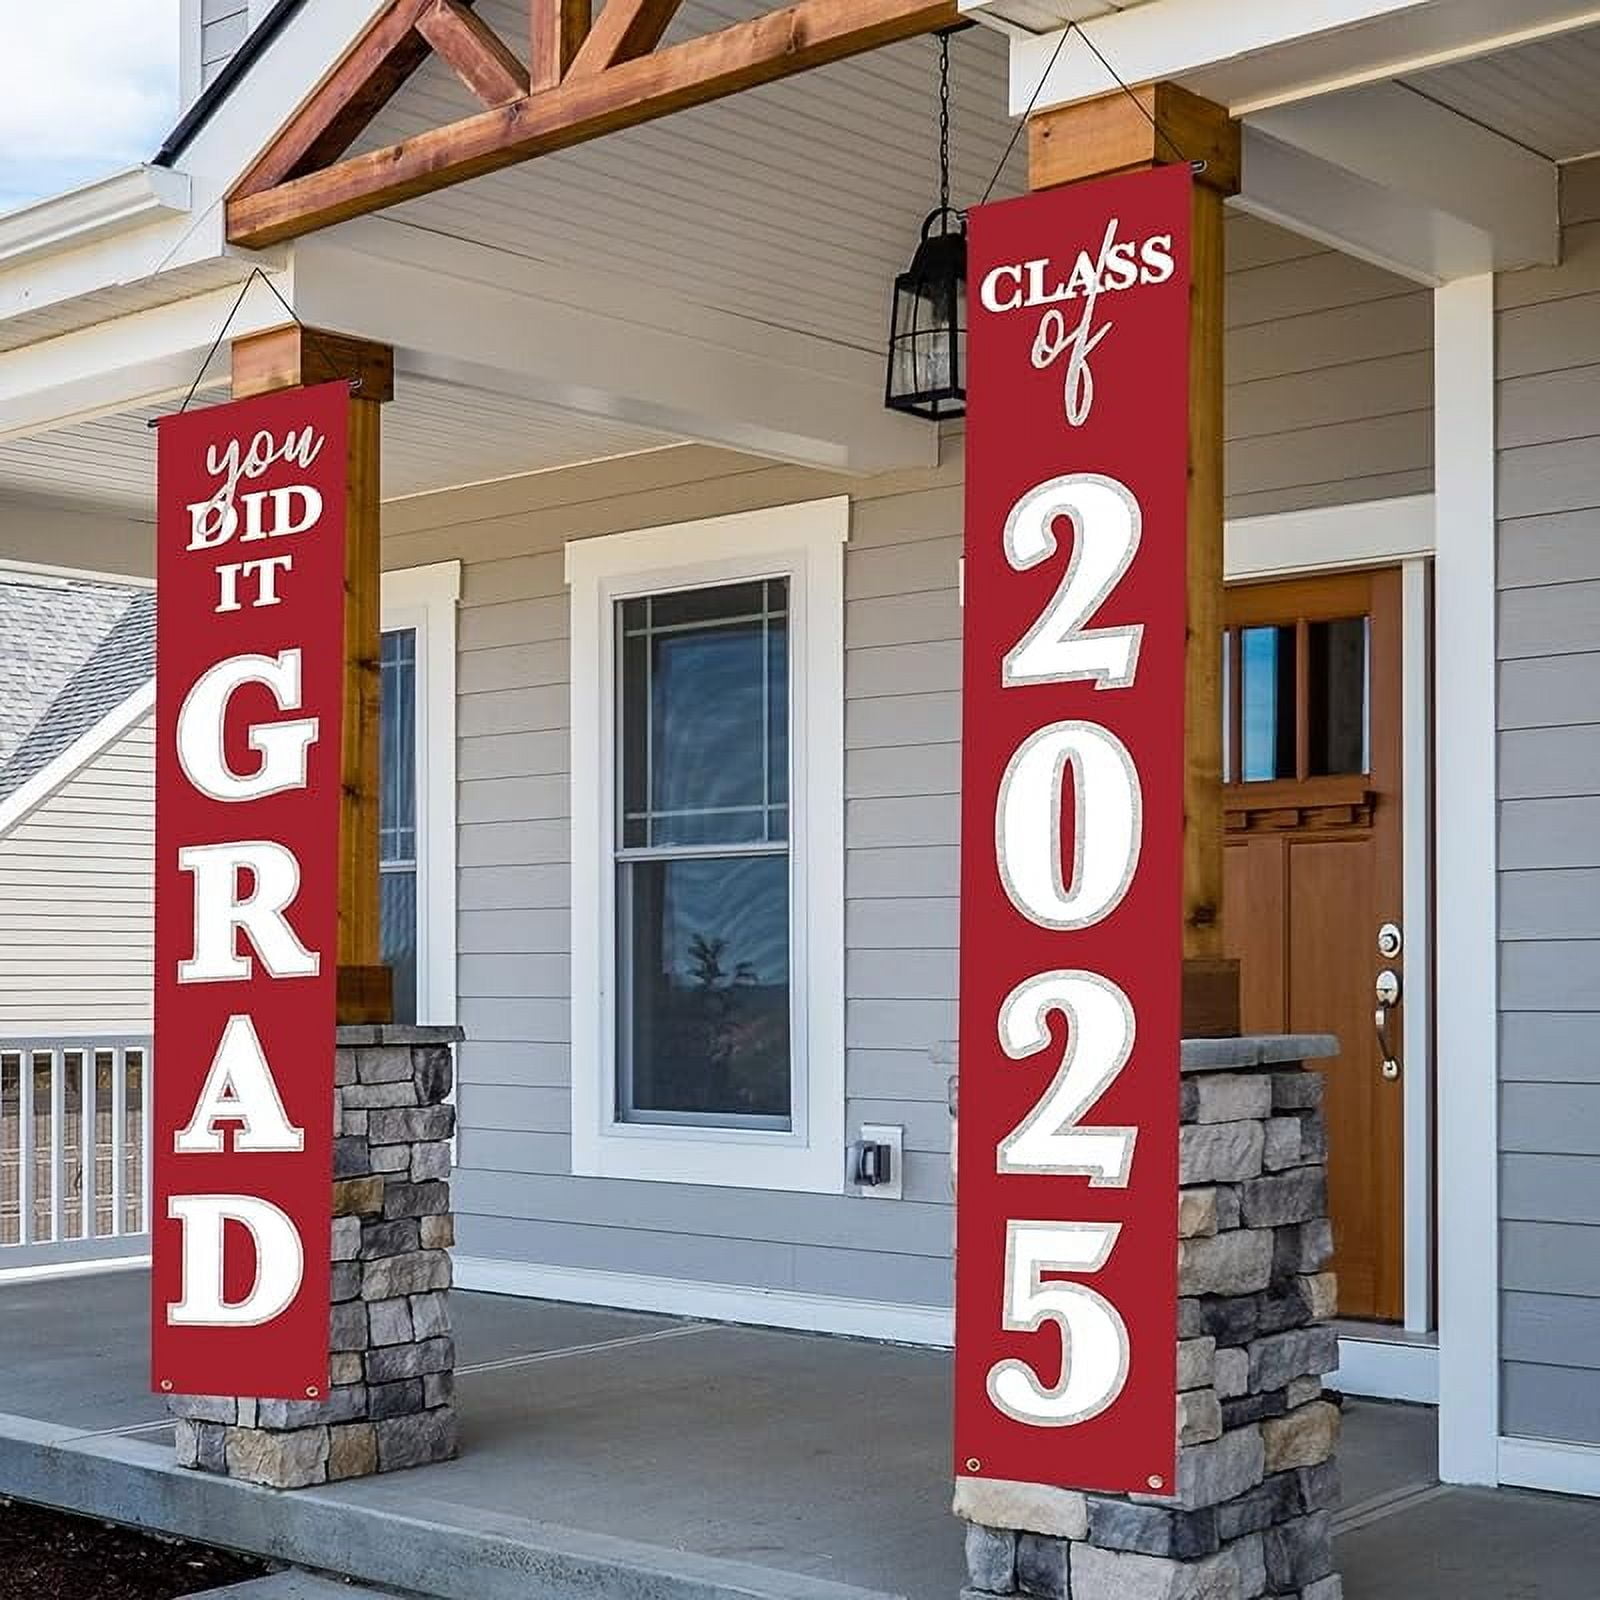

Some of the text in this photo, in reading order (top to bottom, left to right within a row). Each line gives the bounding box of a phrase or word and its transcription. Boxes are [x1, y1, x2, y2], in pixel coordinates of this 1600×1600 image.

[981, 235, 1175, 312] CLASS
[1031, 218, 1119, 427] of
[186, 485, 323, 551] DID
[197, 426, 325, 535] you
[215, 555, 292, 612] IT
[167, 648, 320, 1327] GRAD
[986, 473, 1145, 1427] 2025
